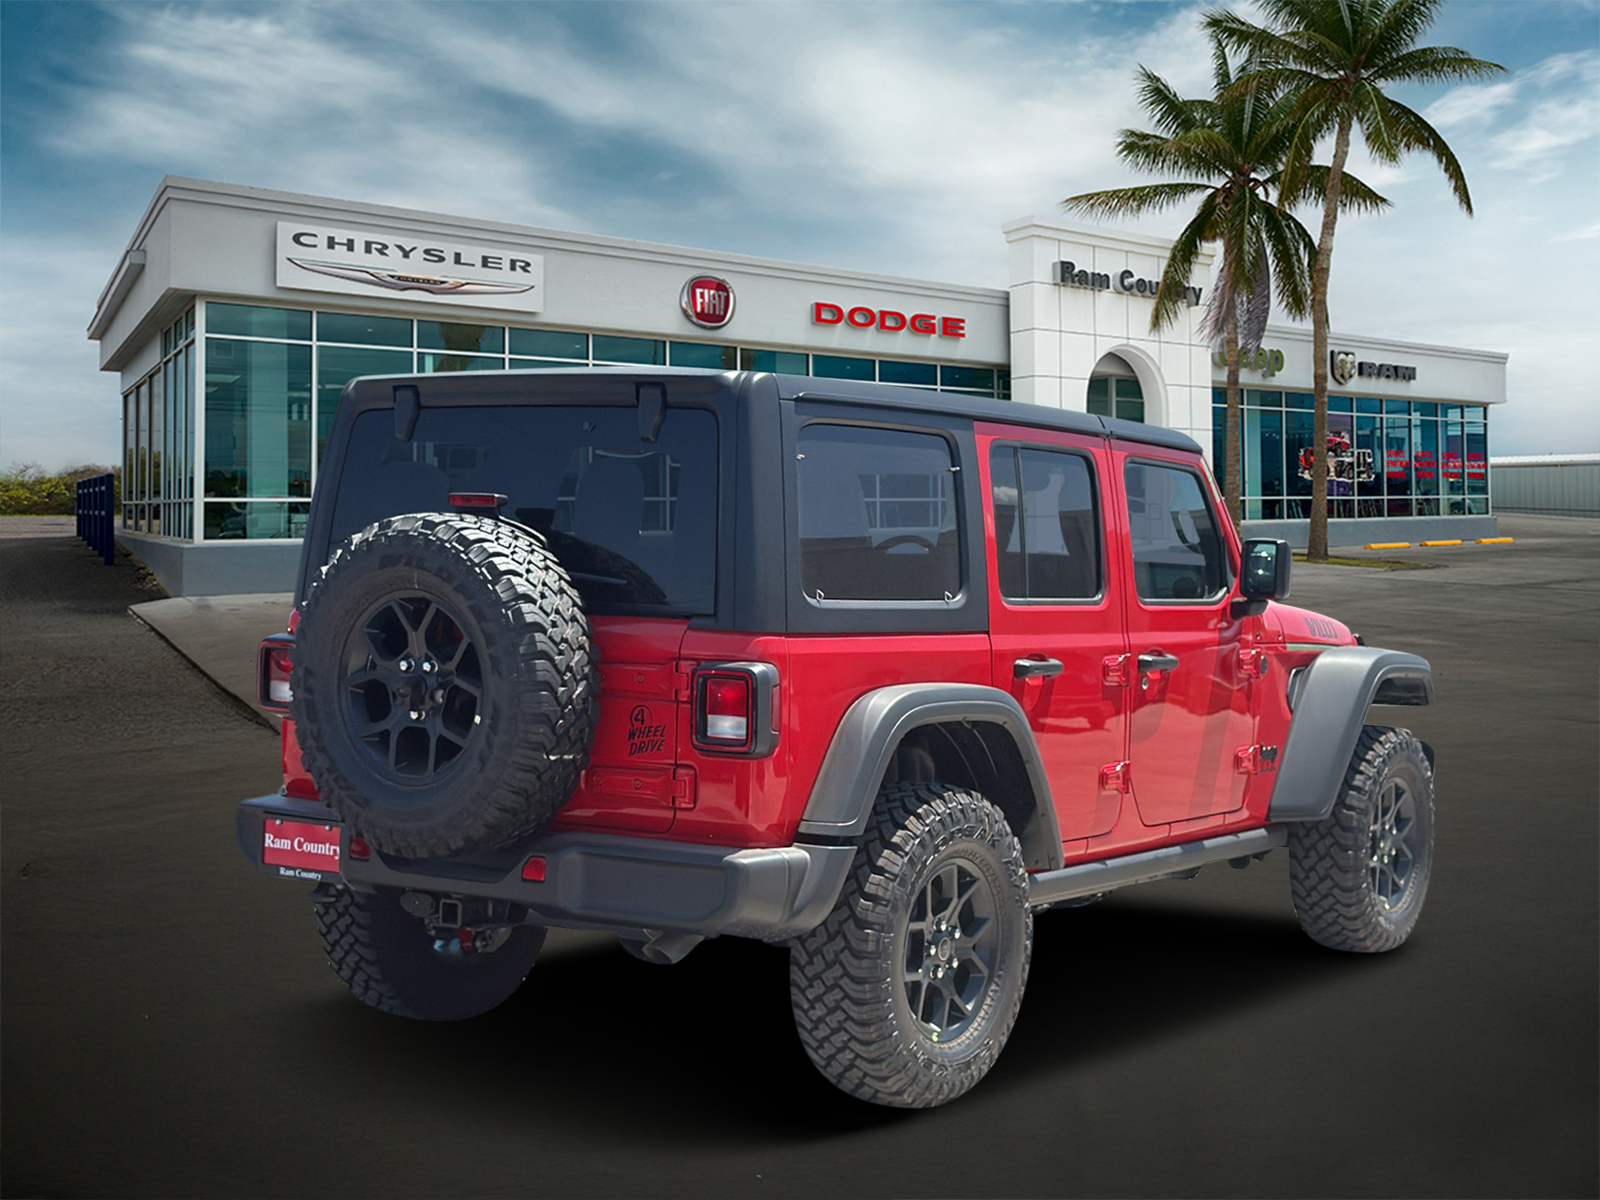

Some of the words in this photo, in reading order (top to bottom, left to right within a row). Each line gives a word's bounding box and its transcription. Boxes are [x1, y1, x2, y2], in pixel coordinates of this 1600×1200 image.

[292, 231, 532, 273] CHRYSLER
[1058, 260, 1111, 290] Ram
[694, 287, 728, 317] FIAT
[813, 301, 967, 339] DODGE
[1358, 361, 1417, 381] RAM
[628, 725, 667, 741] WHEEL
[629, 739, 665, 757] DRIVE
[264, 832, 292, 851] Ram
[293, 836, 340, 860] Country
[279, 866, 295, 877] Ram
[295, 868, 322, 881] Country
